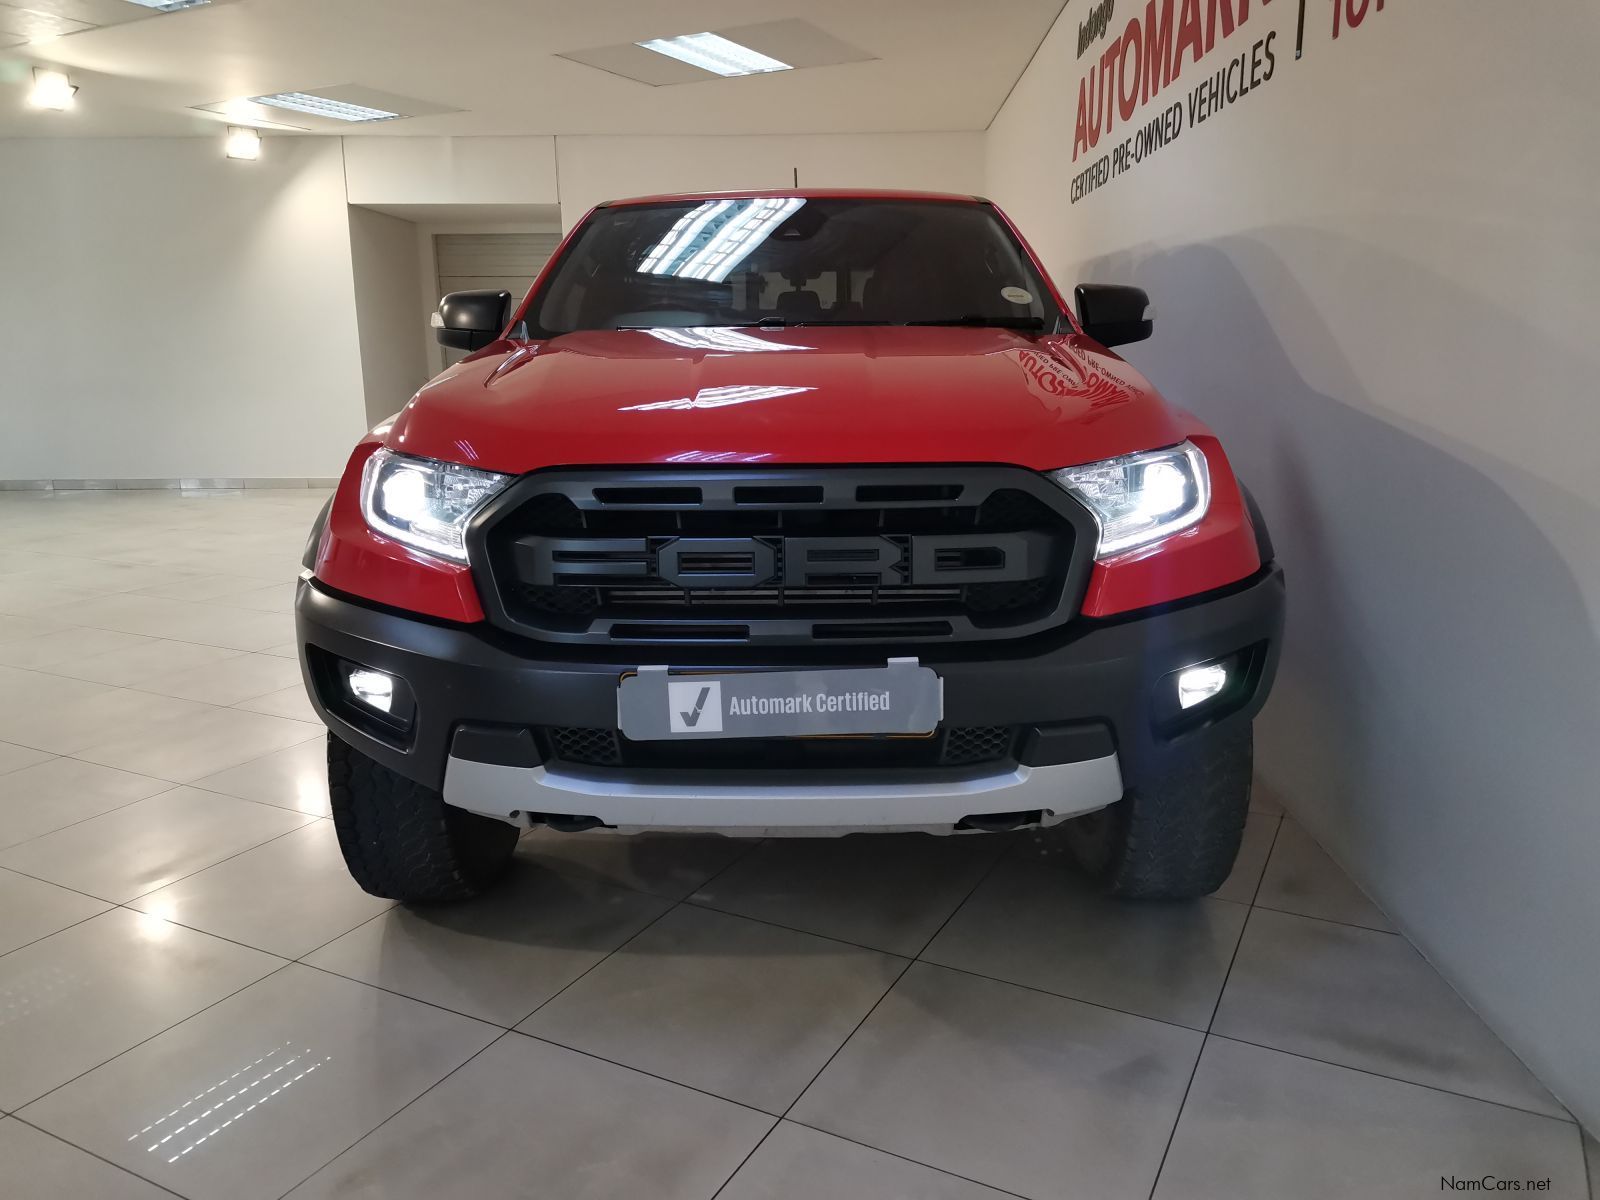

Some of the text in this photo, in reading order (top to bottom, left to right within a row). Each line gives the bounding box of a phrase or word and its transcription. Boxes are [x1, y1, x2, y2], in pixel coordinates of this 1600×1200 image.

[1070, 30, 1277, 205] CERTIFIED PRE-OWNED VEHICLES
[514, 535, 1046, 588] FORD
[729, 691, 890, 716] Automark Certified
